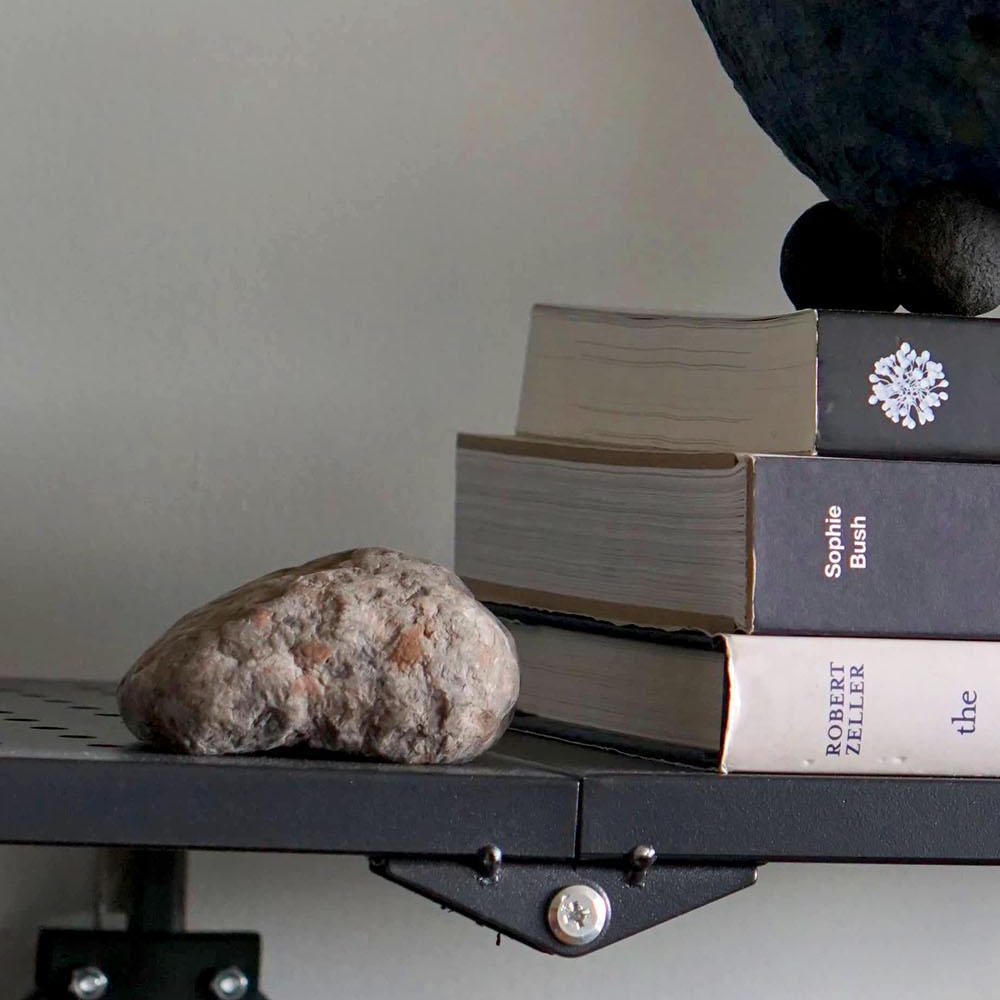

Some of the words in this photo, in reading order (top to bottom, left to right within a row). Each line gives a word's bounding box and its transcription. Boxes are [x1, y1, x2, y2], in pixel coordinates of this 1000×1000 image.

[824, 505, 845, 578] Sophie
[849, 516, 867, 569] Bush
[825, 661, 846, 757] ROBERT
[845, 664, 865, 756] ZELLER
[951, 690, 978, 736] the
